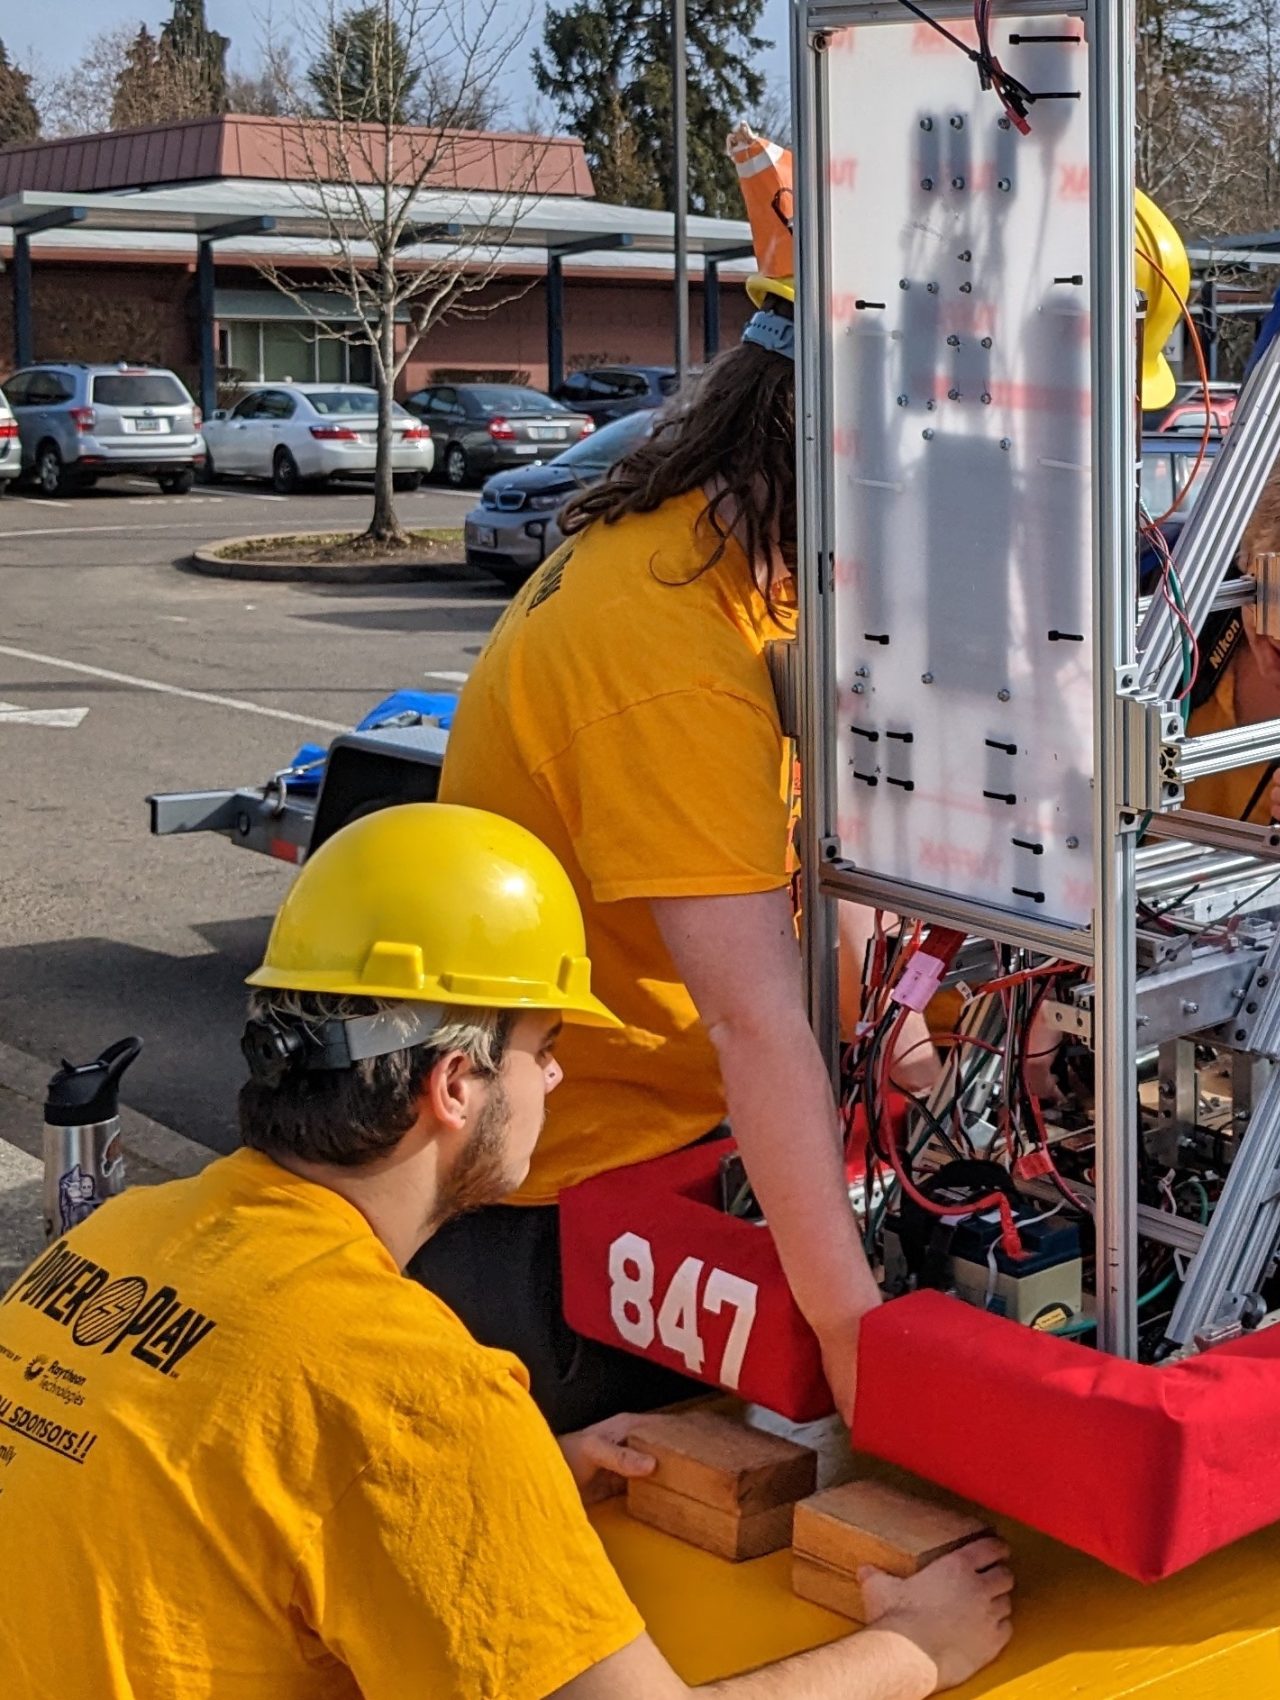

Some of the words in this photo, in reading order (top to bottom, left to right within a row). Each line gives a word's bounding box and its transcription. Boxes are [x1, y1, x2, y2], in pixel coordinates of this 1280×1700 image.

[1209, 619, 1240, 669] Nikon
[2, 1240, 110, 1327] POWER
[101, 1285, 217, 1376] PLAY
[608, 1231, 759, 1390] 847
[48, 1360, 87, 1386] Raytheon
[9, 1406, 98, 1459] sponsors!!
